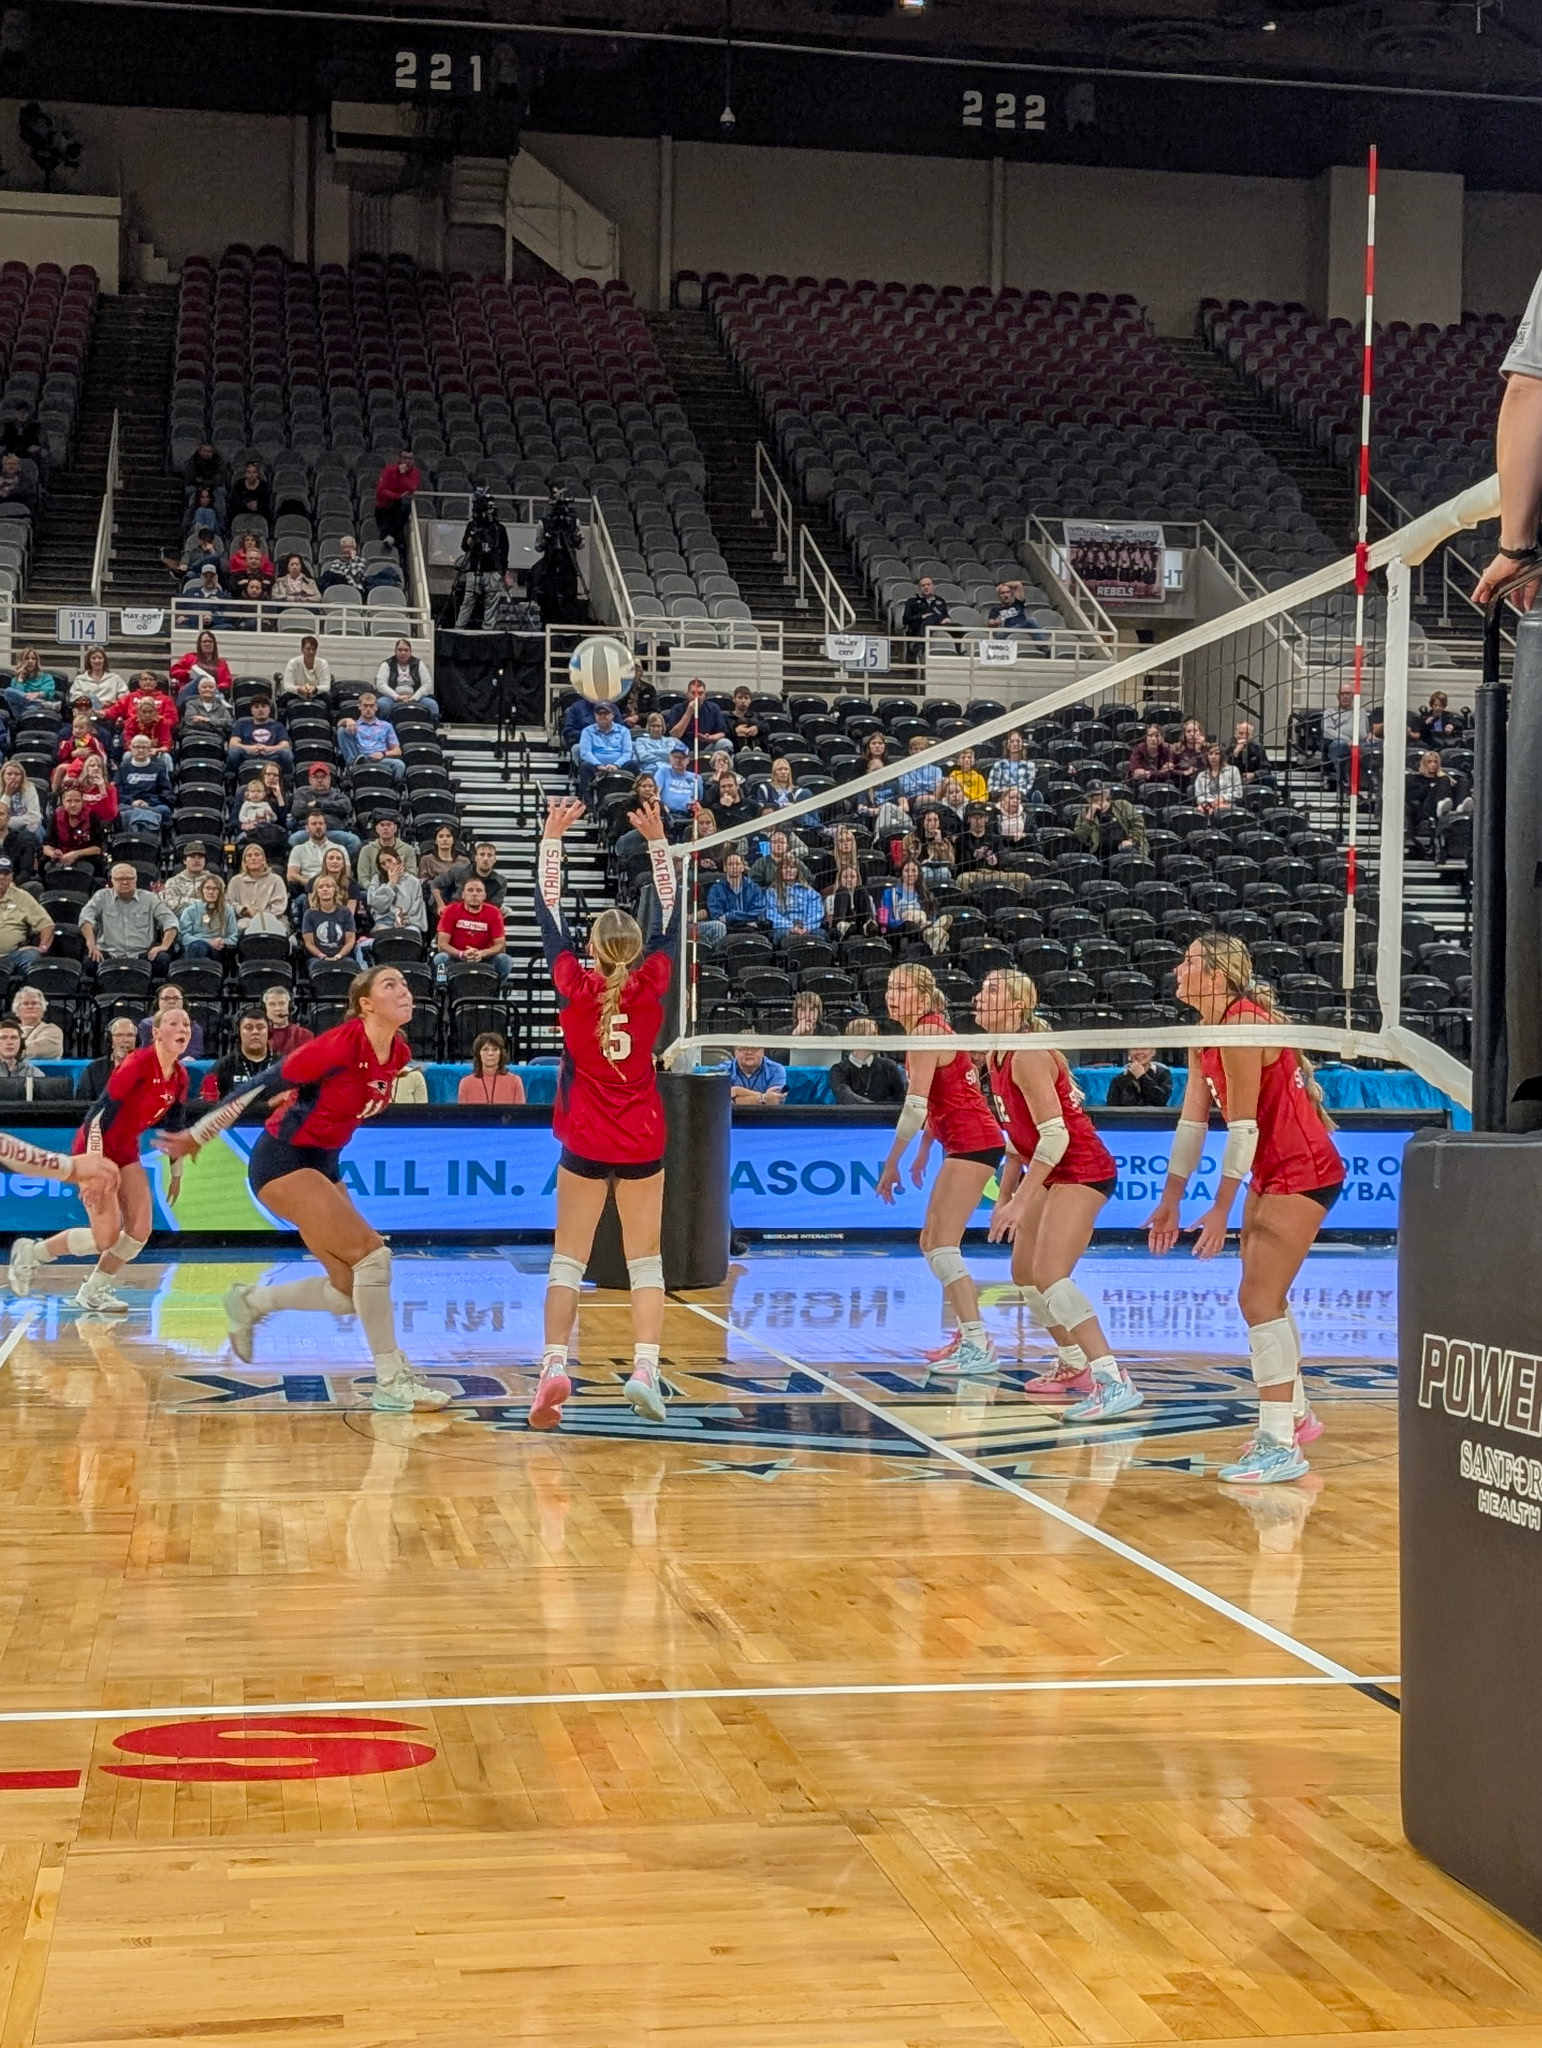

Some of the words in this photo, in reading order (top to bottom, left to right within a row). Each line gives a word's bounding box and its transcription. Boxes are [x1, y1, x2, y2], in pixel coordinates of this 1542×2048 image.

[395, 51, 481, 92] 221
[962, 90, 1045, 130] 222
[1097, 586, 1134, 597] REBELS
[70, 619, 96, 640] 114
[603, 1013, 631, 1060] 5
[447, 1160, 525, 1197] IN.
[1478, 1488, 1541, 1530] HEALTH
